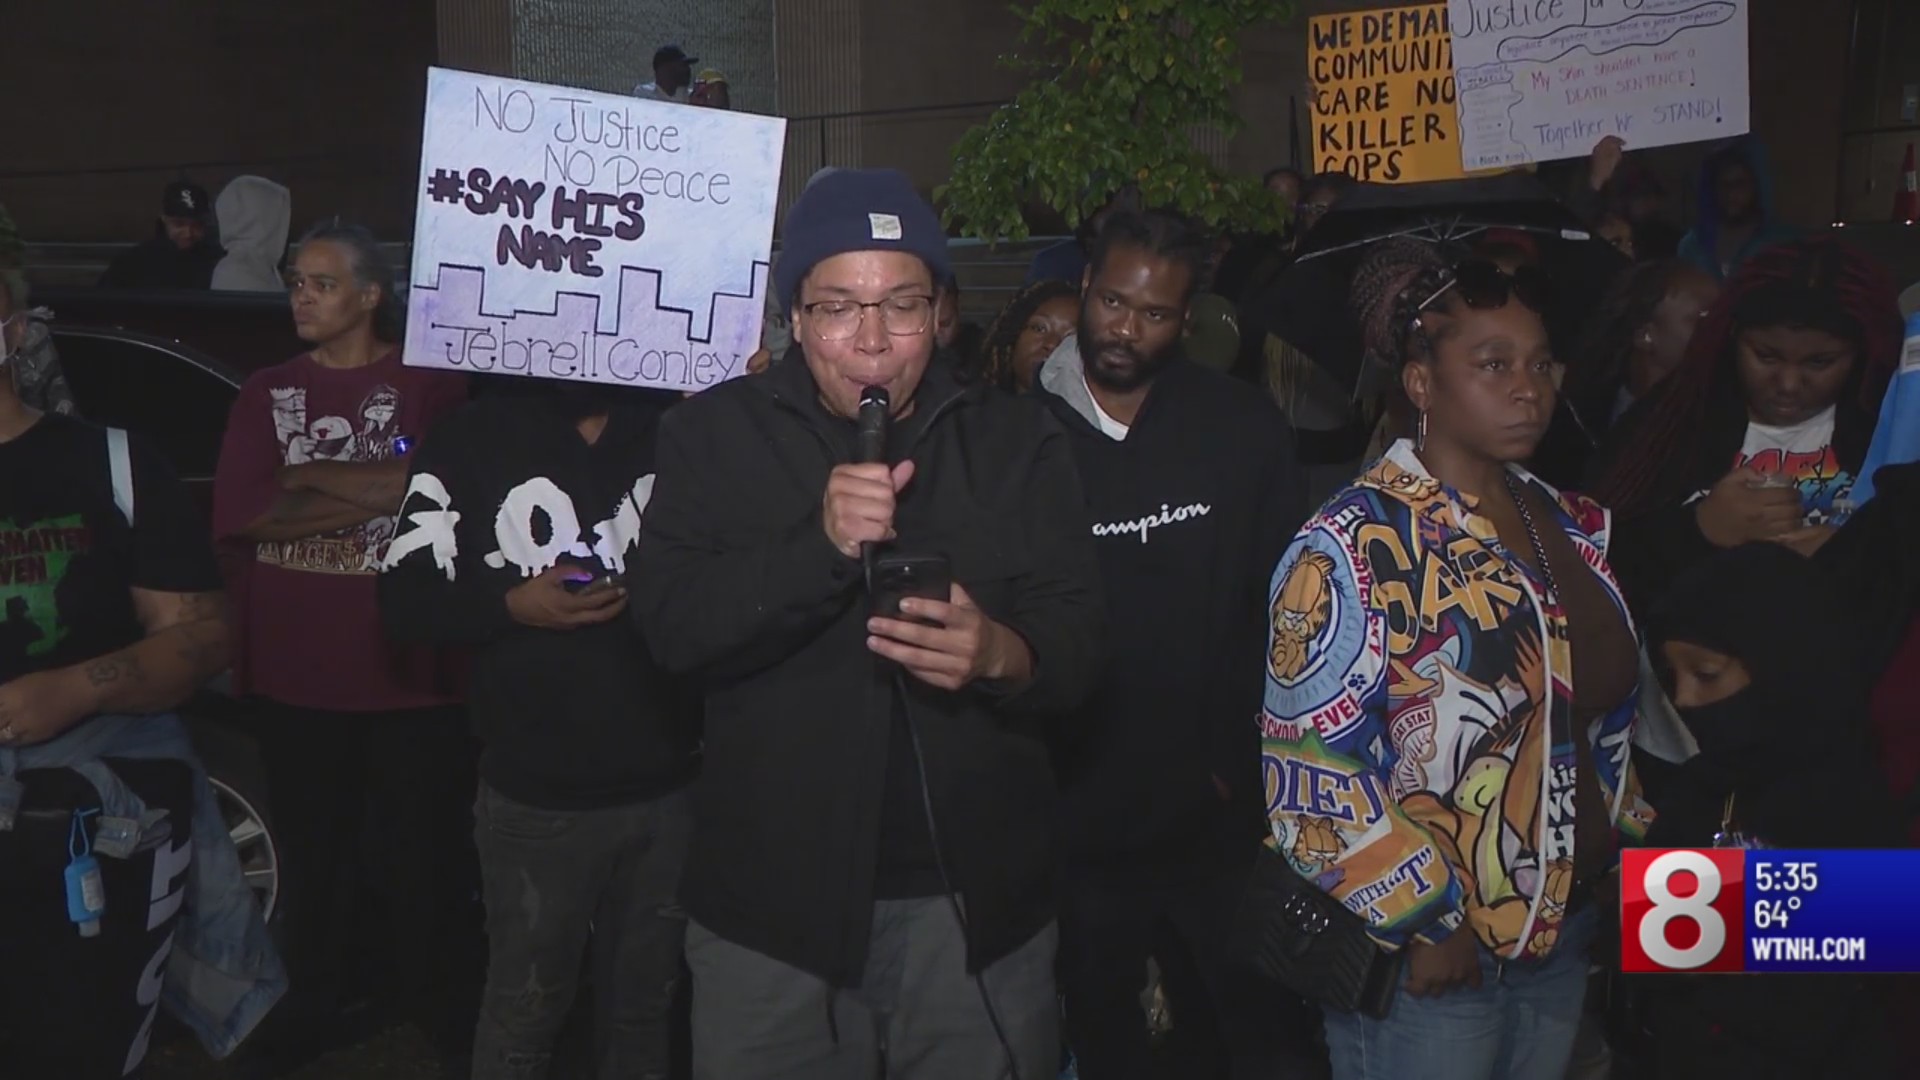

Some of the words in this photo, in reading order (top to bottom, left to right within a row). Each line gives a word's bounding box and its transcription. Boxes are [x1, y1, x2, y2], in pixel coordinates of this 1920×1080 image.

[1314, 18, 1351, 50] WE
[1531, 71, 1550, 91] My
[1688, 47, 1696, 58] a
[475, 86, 535, 133] NO
[1316, 81, 1389, 115] CARE
[1565, 87, 1607, 105] DEATH
[1321, 113, 1445, 152] KILLER
[1533, 118, 1604, 146] Together
[1653, 97, 1722, 124] STAND!
[544, 145, 595, 187] NO
[603, 156, 731, 204] Peace
[1324, 150, 1403, 180] COPS
[427, 167, 545, 220] #SAY
[552, 186, 646, 241] HIS
[497, 223, 604, 277] NAME
[431, 321, 598, 377] Jebrell
[608, 338, 740, 386] Conley
